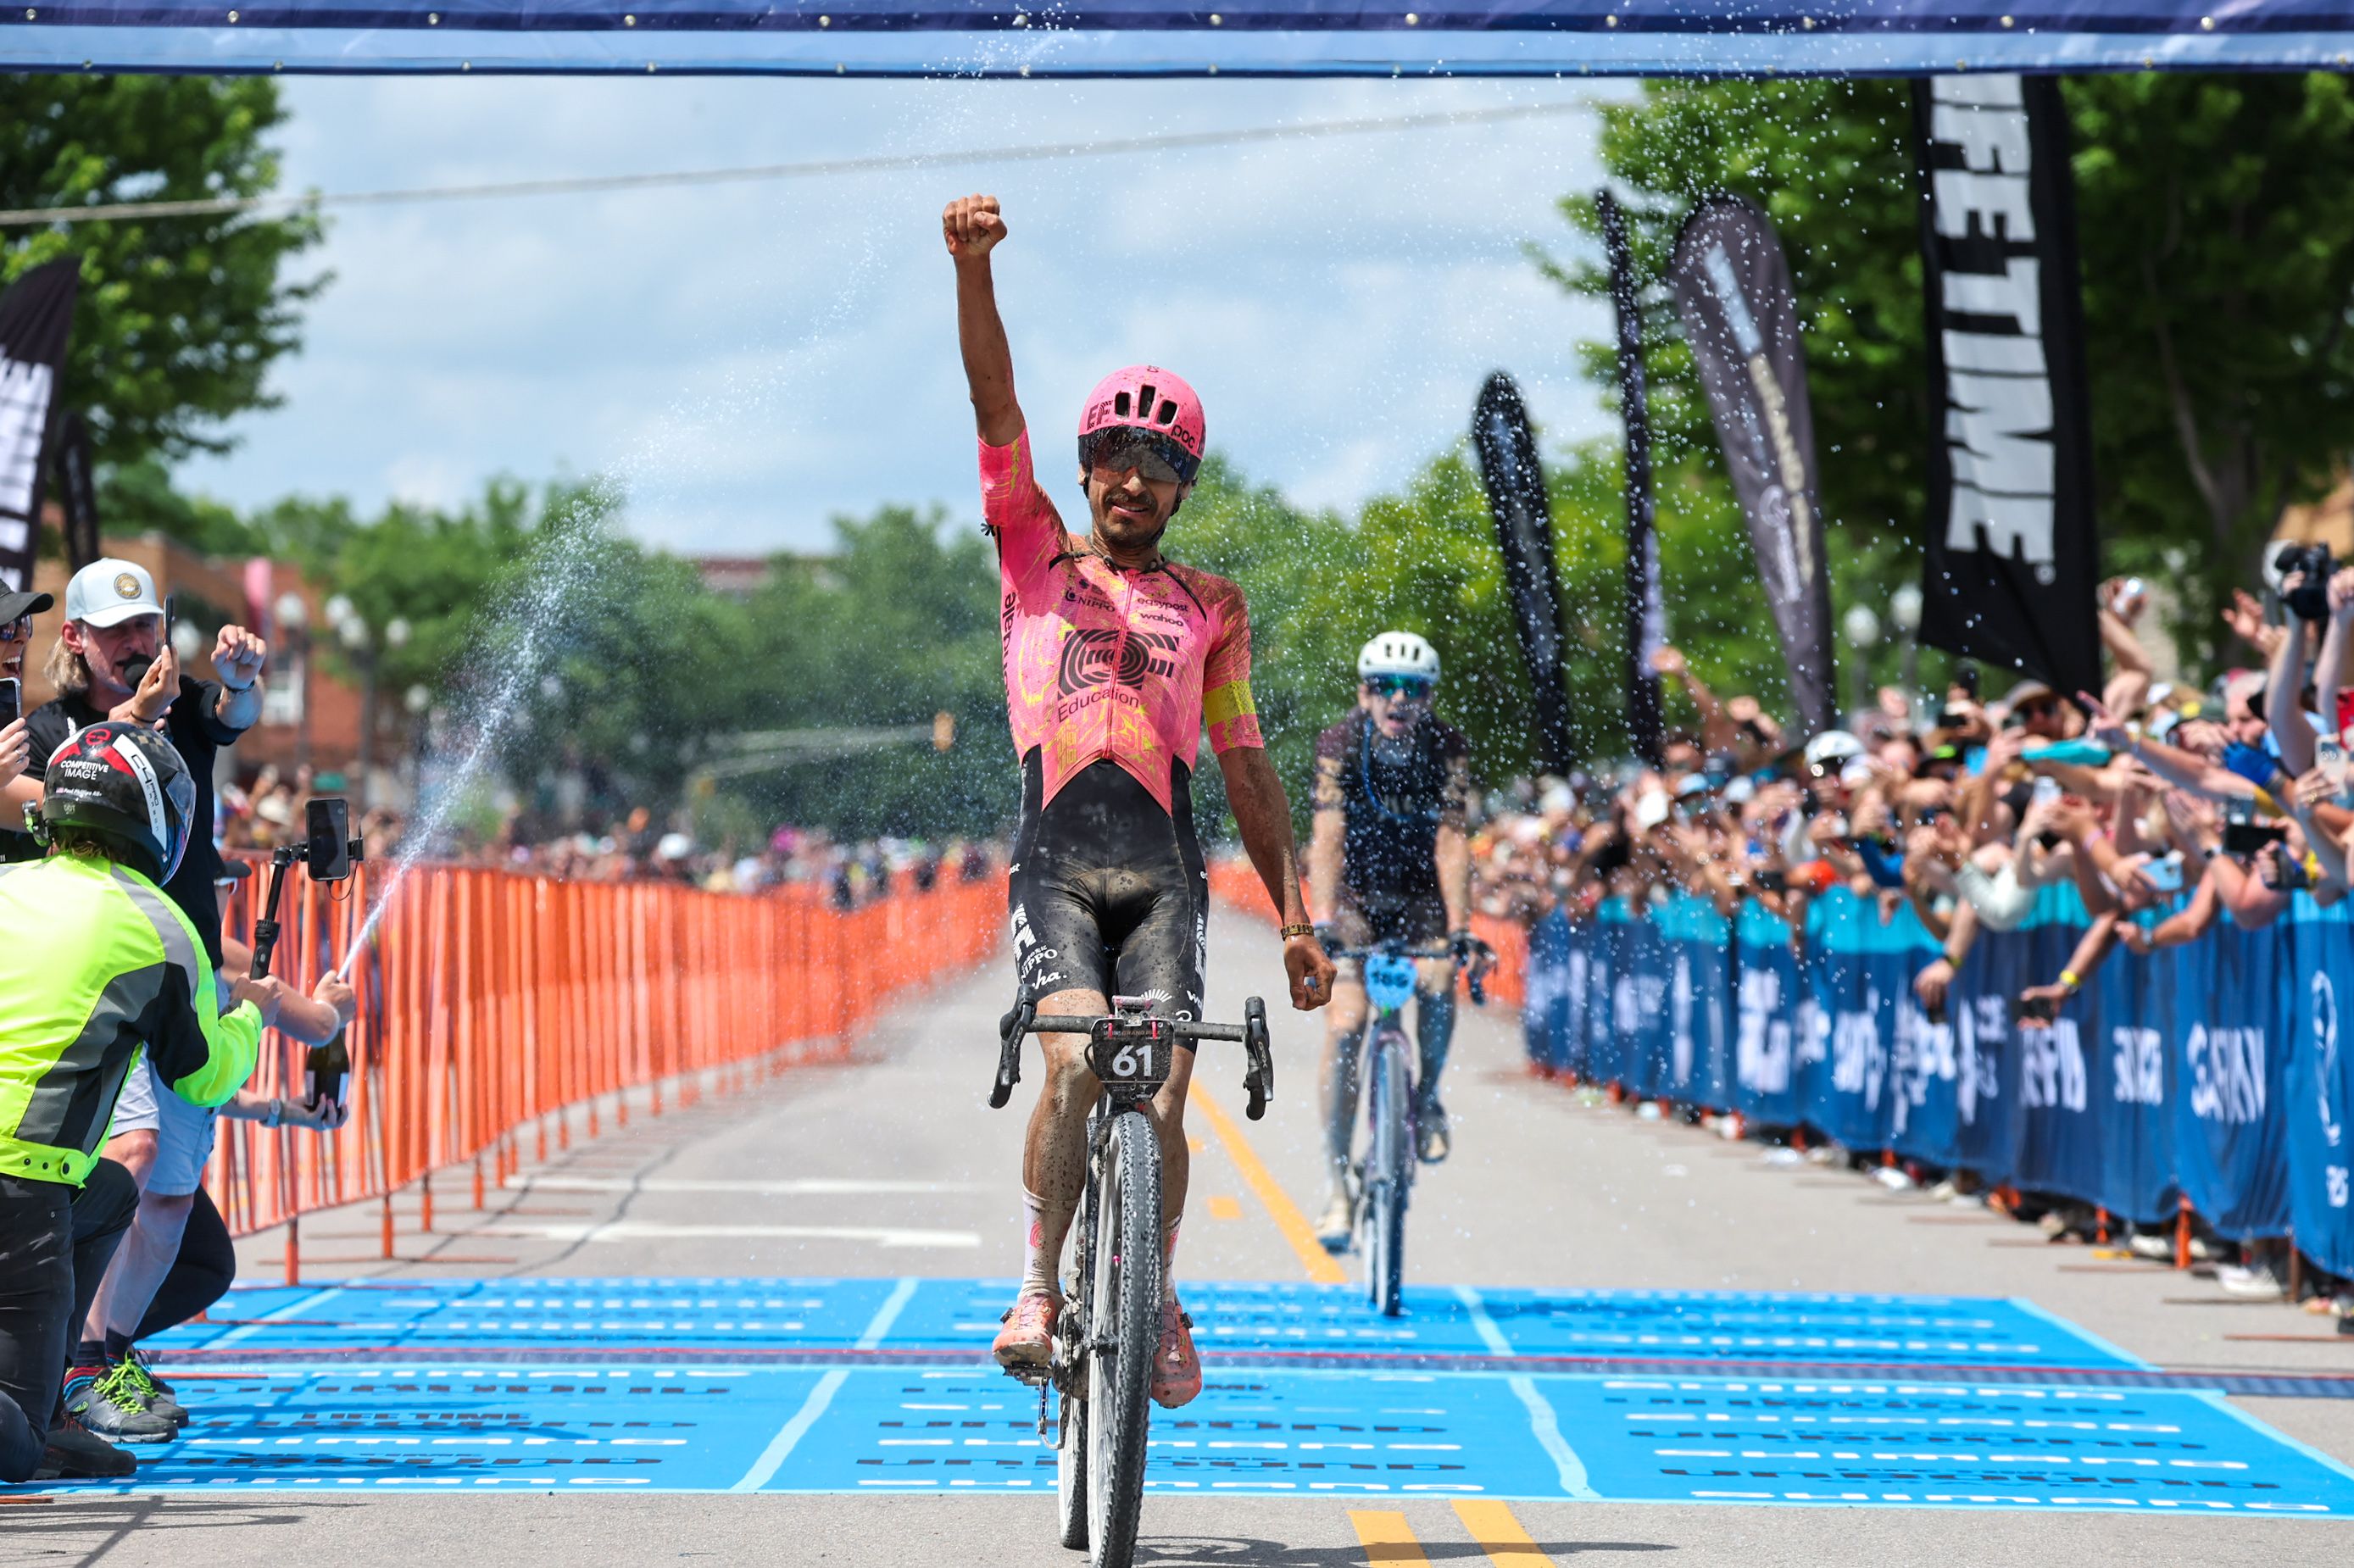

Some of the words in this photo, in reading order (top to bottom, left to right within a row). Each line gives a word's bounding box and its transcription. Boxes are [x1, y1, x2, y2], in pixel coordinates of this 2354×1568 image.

[1930, 75, 2036, 241] IFE
[1941, 256, 2055, 564] TIME
[1077, 597, 1116, 612] NIPPO
[1137, 597, 1188, 612] easypost
[1139, 612, 1184, 627] wahoo
[1057, 688, 1140, 722] Education
[60, 759, 109, 773] COMPETITIVE
[64, 768, 97, 780] IMAGE
[1111, 1044, 1152, 1077] 61
